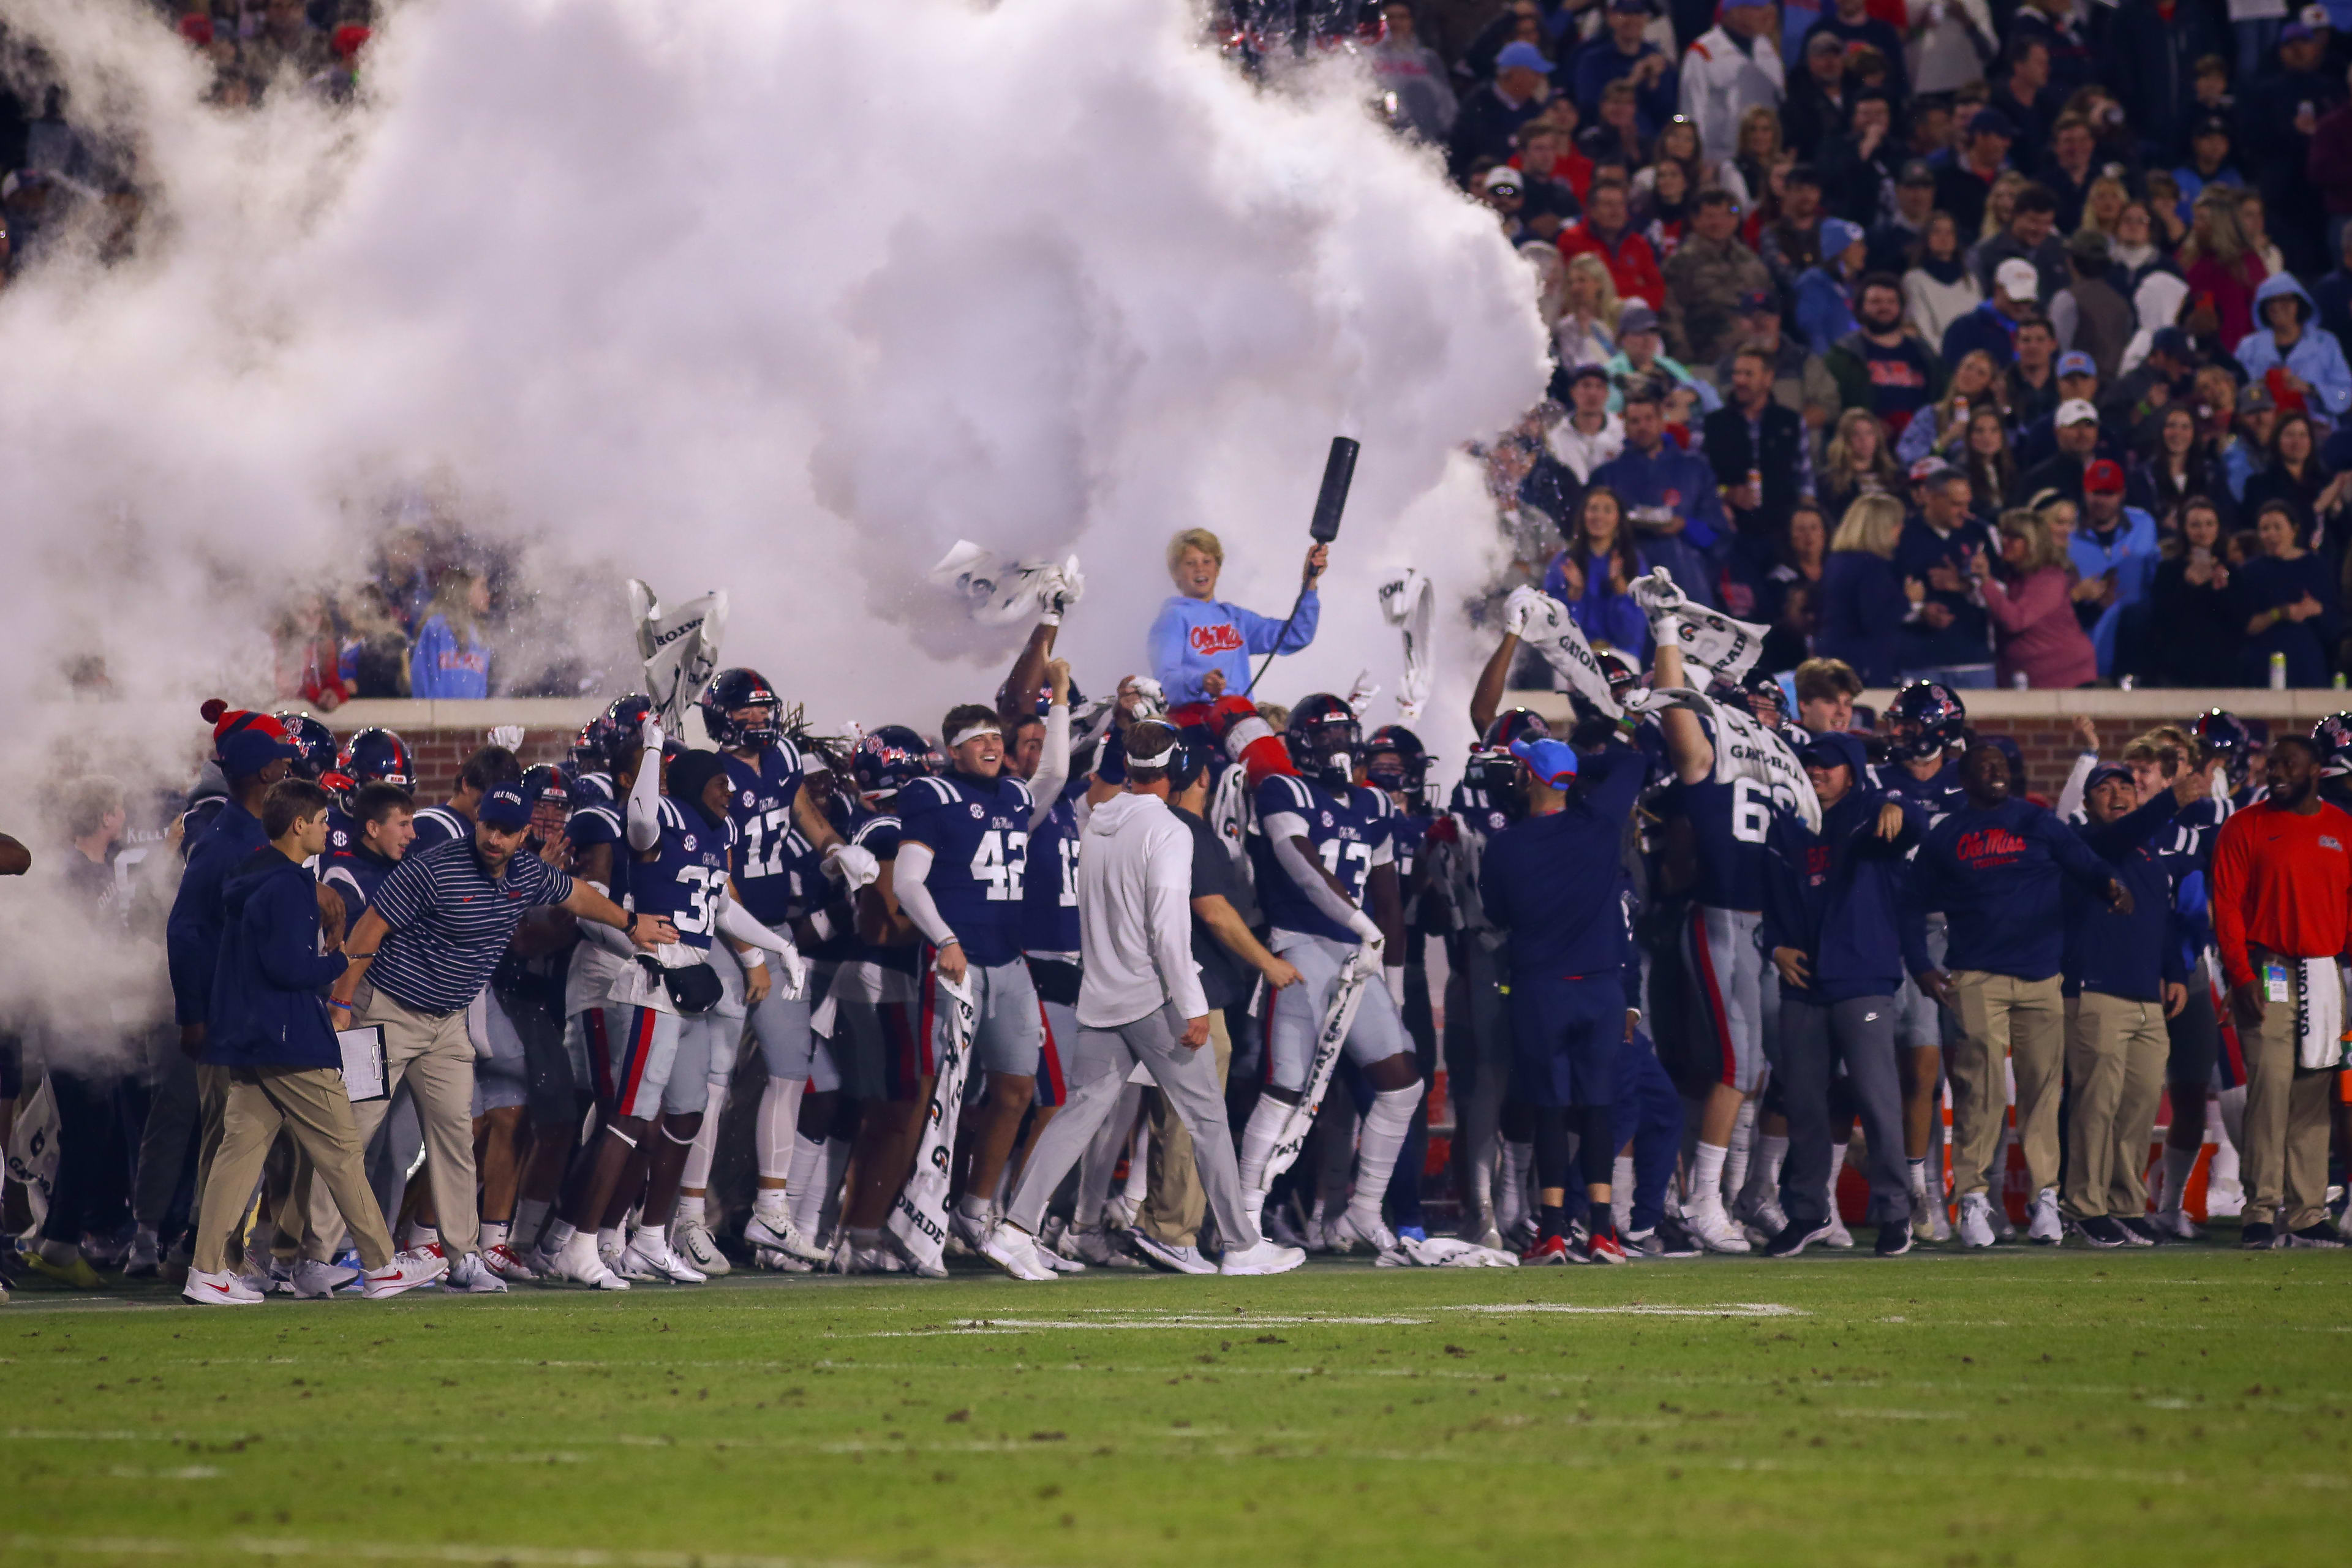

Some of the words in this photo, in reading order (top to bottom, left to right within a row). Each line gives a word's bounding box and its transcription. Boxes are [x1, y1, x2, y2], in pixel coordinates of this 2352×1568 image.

[493, 790, 505, 799] OLE
[505, 791, 522, 805] MISS
[333, 830, 347, 847] SEC
[743, 805, 790, 878] 17
[1956, 831, 1985, 861] Ole
[1983, 828, 2027, 854] Miss
[970, 831, 1028, 901] 42
[1319, 839, 1373, 909] 13
